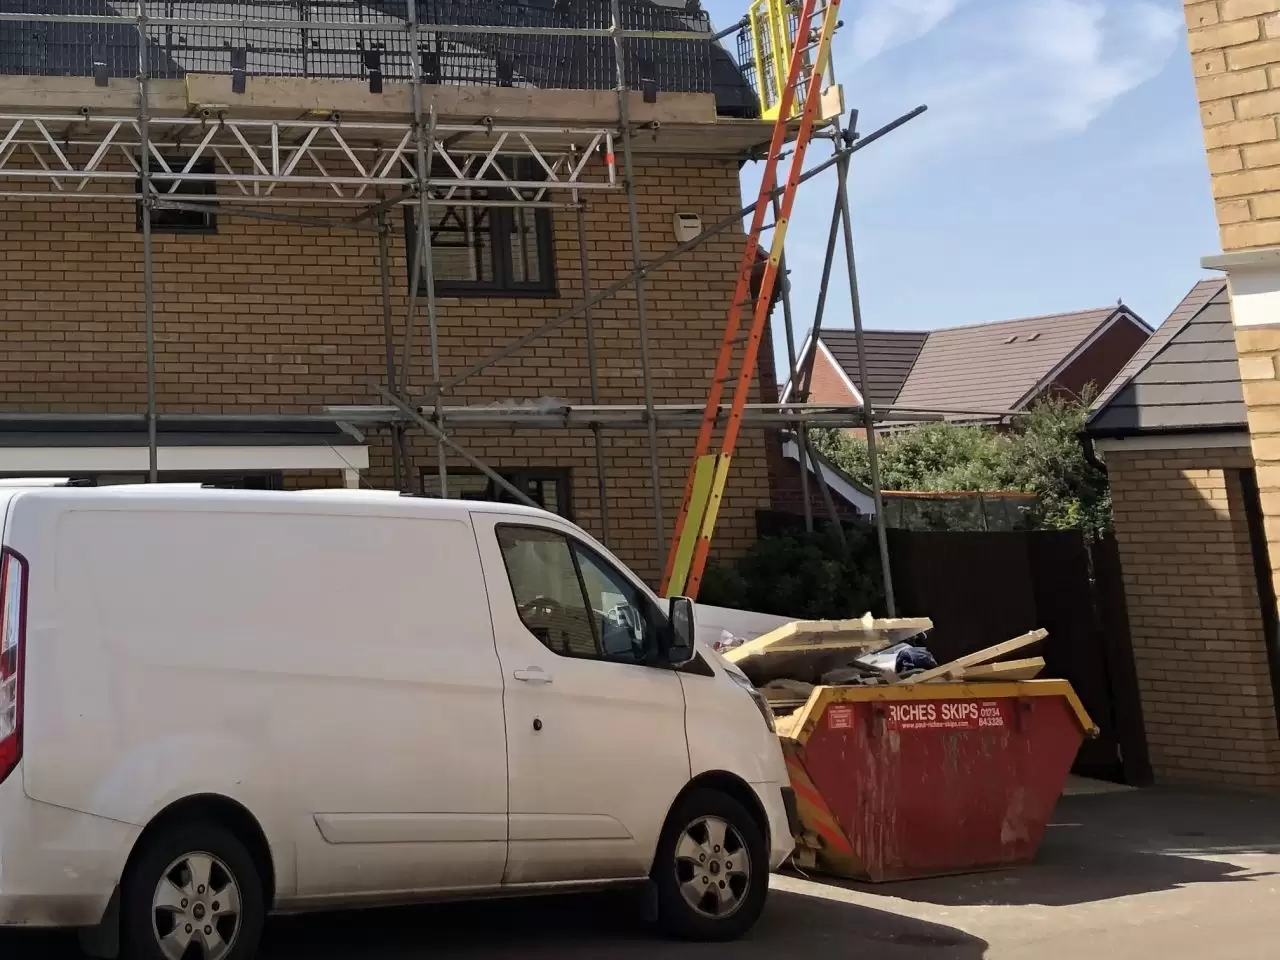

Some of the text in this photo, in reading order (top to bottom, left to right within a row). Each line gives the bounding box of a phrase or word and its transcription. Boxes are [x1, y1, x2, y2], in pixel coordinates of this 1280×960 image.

[888, 703, 979, 721] RICHES SKIPS
[980, 707, 1001, 717] 01234
